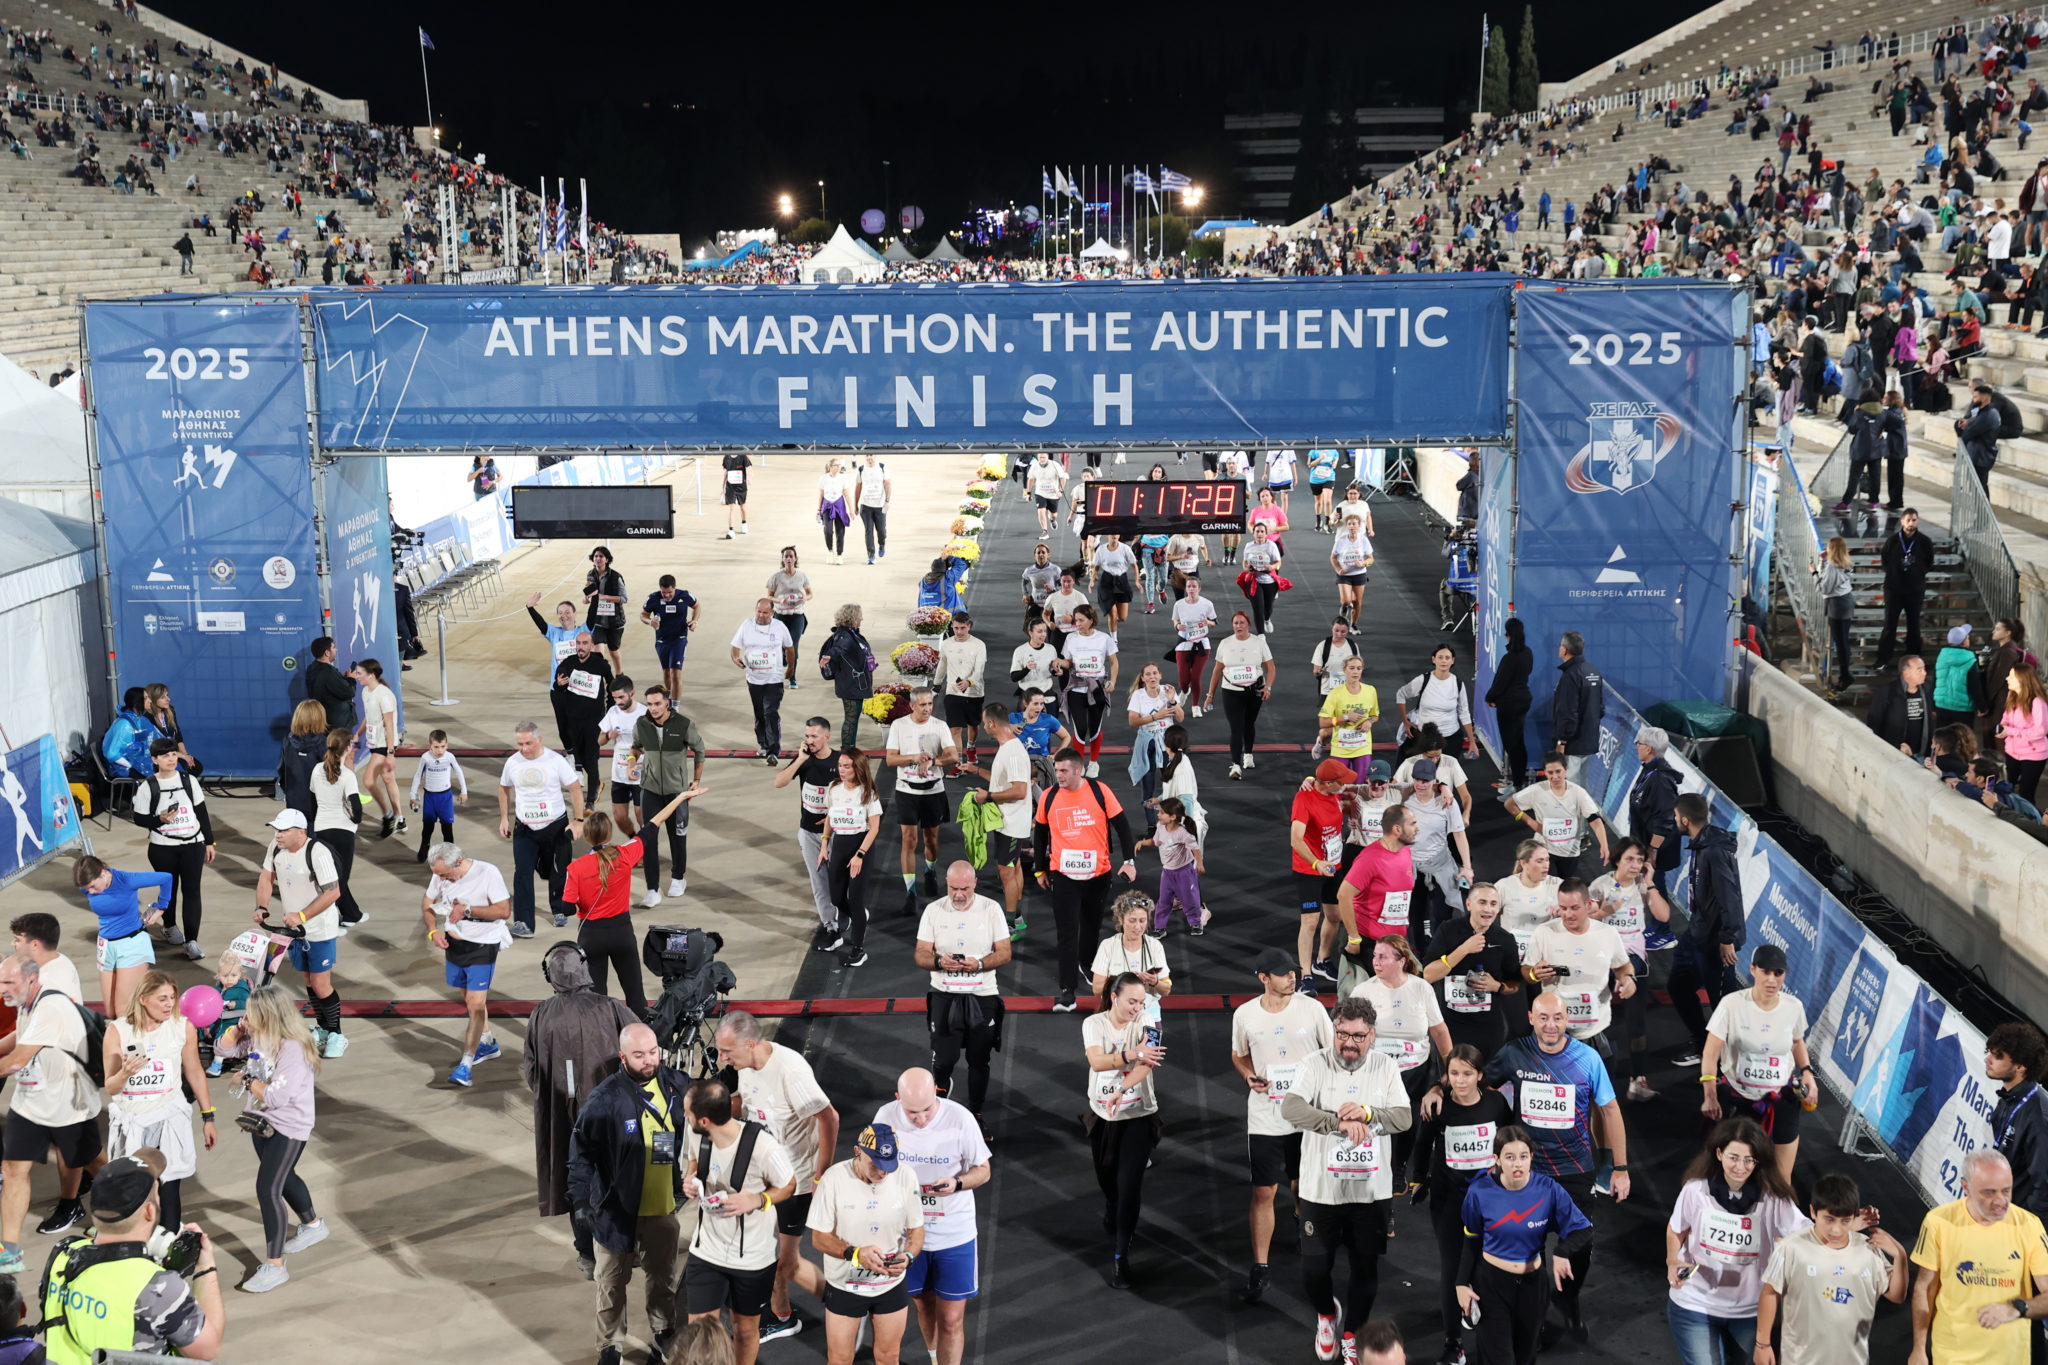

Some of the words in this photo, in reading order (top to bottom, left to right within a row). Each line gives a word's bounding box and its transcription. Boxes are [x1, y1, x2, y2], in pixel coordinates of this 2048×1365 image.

[484, 316, 688, 357] ATHENS
[708, 312, 1014, 355] MARATHON.
[1032, 311, 1132, 352] THE
[1150, 305, 1449, 352] AUTHENTIC
[1568, 332, 1682, 366] 2025
[143, 347, 250, 380] 2025
[778, 373, 1133, 430] FINISH
[162, 409, 241, 419] ΜΑΡΑΘΩΝΙΟΣ
[1589, 402, 1657, 417] ΣΕΓΑΣ
[178, 421, 227, 430] ΑΘΗΝΑΣ
[181, 431, 234, 439] ΑΥΘΕΝΤΙΚΟΣ
[1096, 485, 1236, 516] 01:17:28
[337, 508, 380, 539] ΜΑΡΑΘΩΝΙΟΣ
[348, 529, 374, 553] ΑΘΗΝΑΣ
[1568, 590, 1624, 598] ΠΕΡΙΦΕΡΕΙΑ
[1626, 589, 1666, 597] ΑΤΤΙΚΗΣ
[1232, 673, 1252, 681] 63102
[1065, 860, 1092, 869] 66363
[1608, 917, 1638, 928] 64954
[1768, 881, 1819, 951] Μαραθώνιος
[1861, 967, 1881, 990] ATHENS
[1854, 975, 1880, 1005] MARATHON
[1566, 1005, 1592, 1015] 6372
[128, 1074, 165, 1087] 62027
[1743, 1067, 1780, 1080] 64284
[1529, 1098, 1567, 1112] 52846
[1961, 1074, 1995, 1126] Mara
[1953, 1115, 1976, 1155] The
[1453, 1139, 1491, 1154] 64457
[898, 1151, 950, 1165] Dialectica
[1336, 1150, 1373, 1163] 63363
[1709, 1227, 1752, 1246] 72190
[48, 1281, 107, 1320] PHOTO
